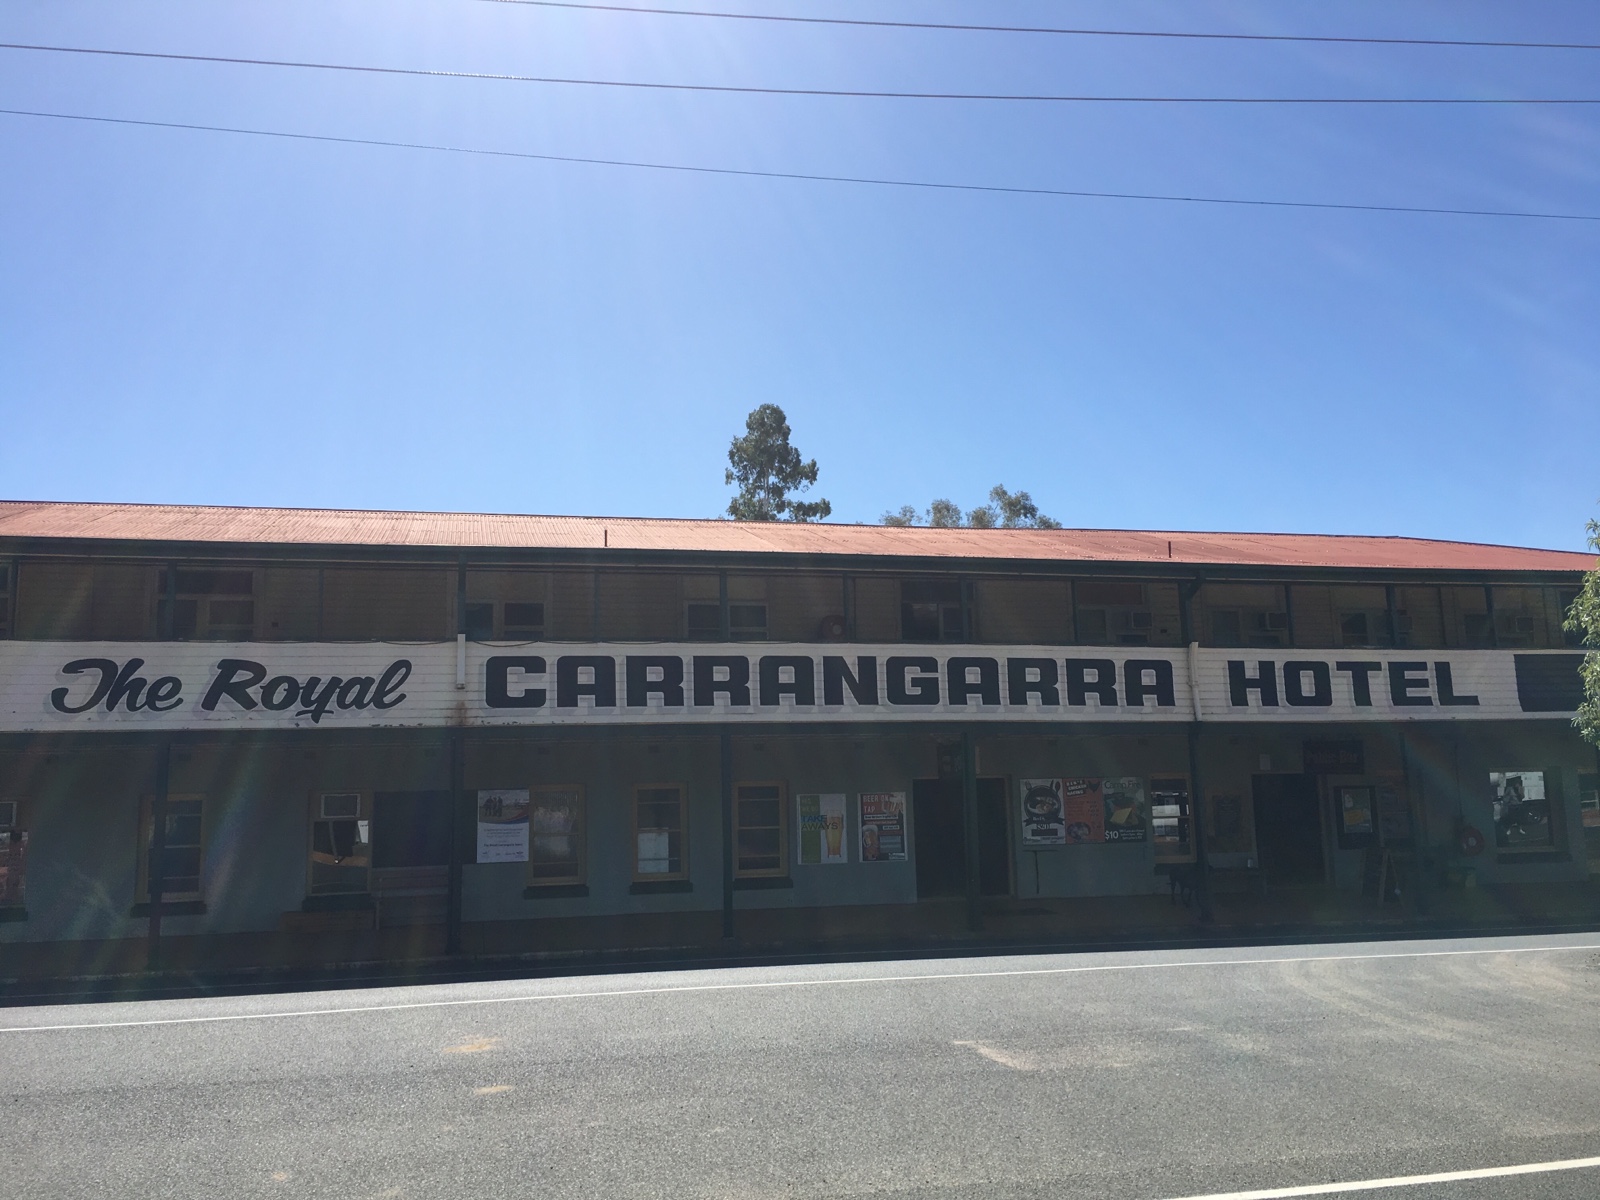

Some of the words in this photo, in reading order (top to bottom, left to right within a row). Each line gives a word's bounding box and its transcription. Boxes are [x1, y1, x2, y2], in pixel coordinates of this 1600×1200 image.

[51, 658, 184, 714] The
[201, 659, 412, 724] Royal
[485, 655, 1175, 708] CARRANGARRA
[1227, 660, 1480, 707] HOTEL
[1104, 780, 1127, 790] Camp
[863, 794, 879, 803] BEER
[863, 805, 876, 813] TAP
[801, 814, 828, 823] TAKE
[801, 822, 839, 831] AWAYS
[1104, 830, 1119, 840] $10
